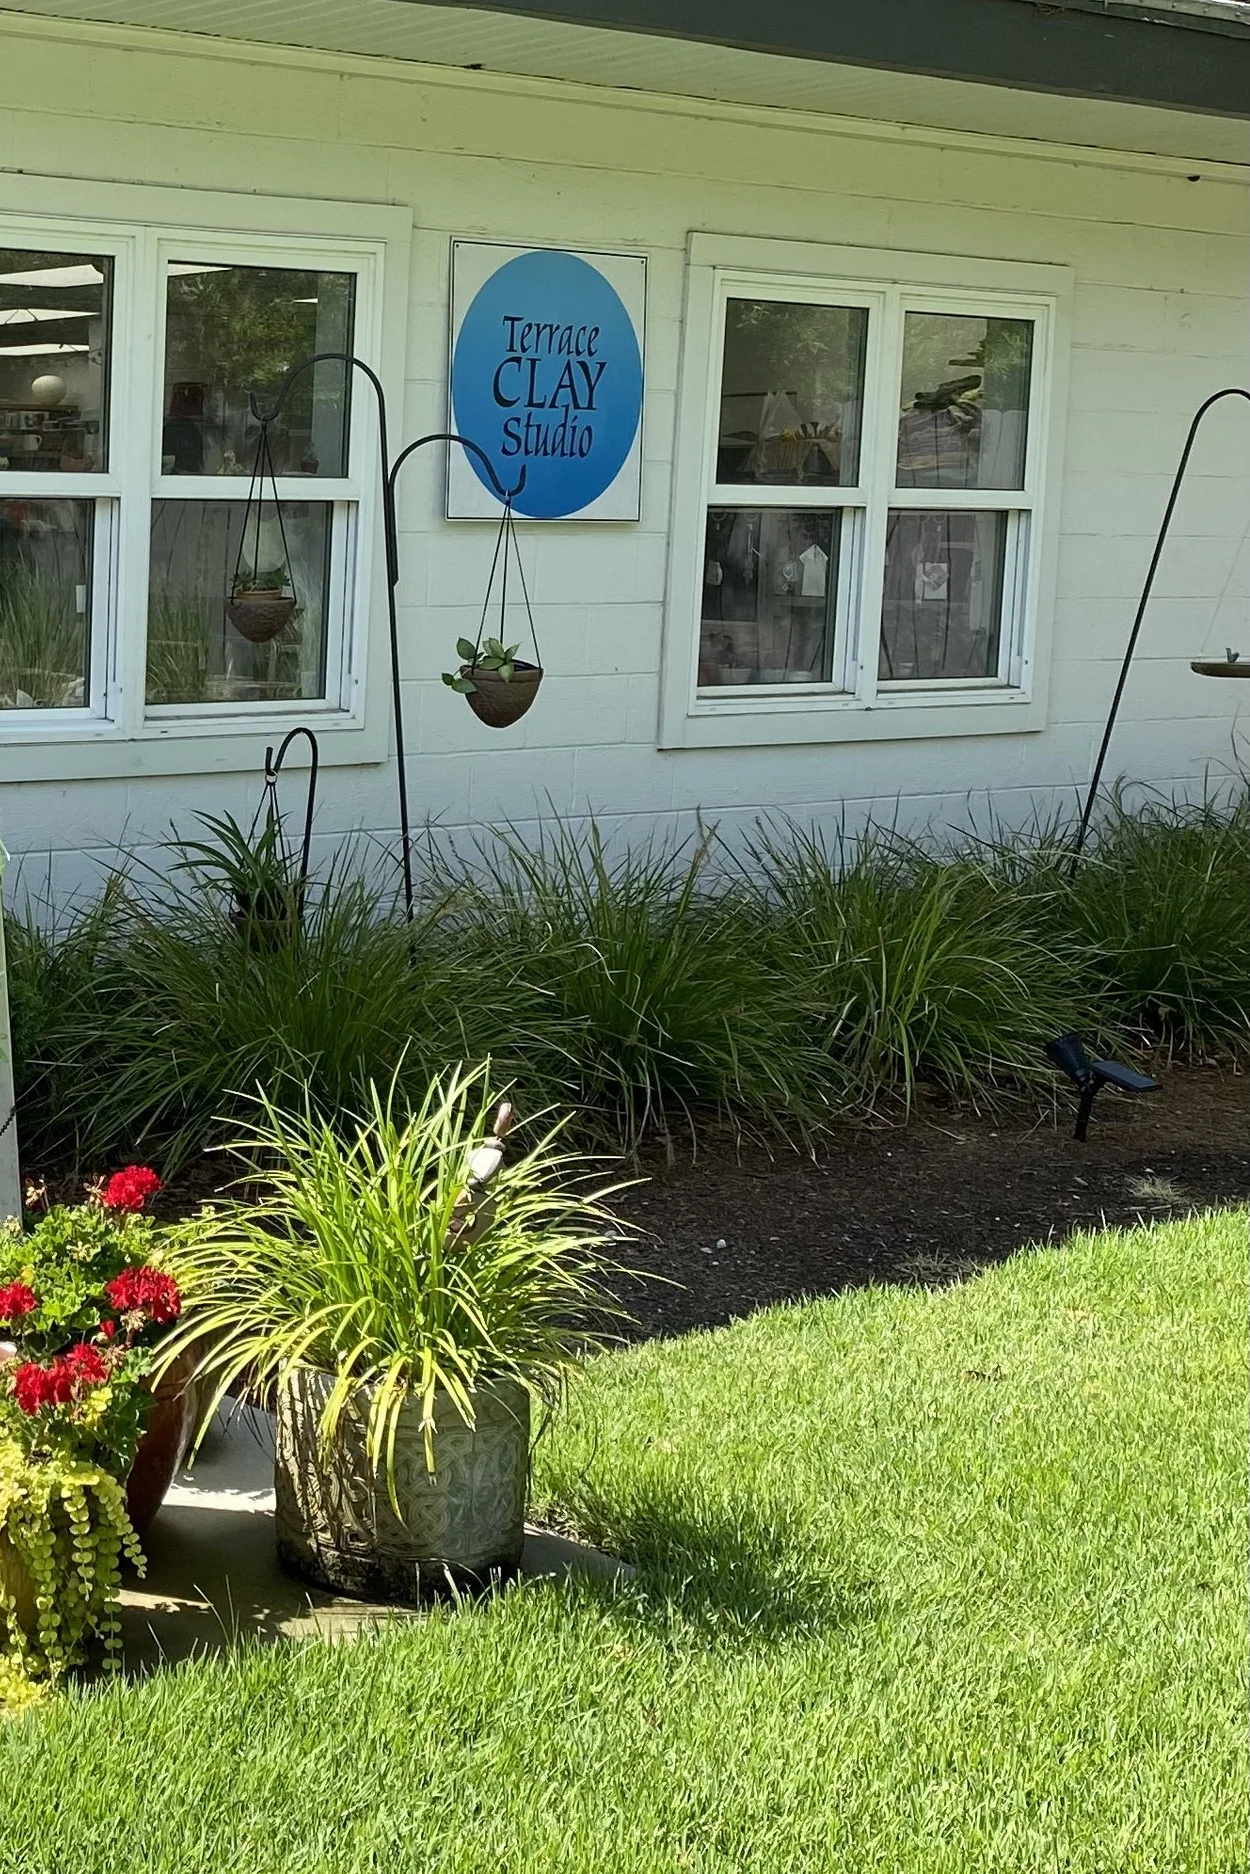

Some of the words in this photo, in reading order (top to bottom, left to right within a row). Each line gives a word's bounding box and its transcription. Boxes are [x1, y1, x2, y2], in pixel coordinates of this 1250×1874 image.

[503, 315, 600, 357] Terrace
[493, 356, 607, 411] CLAY
[501, 404, 593, 458] Studio
